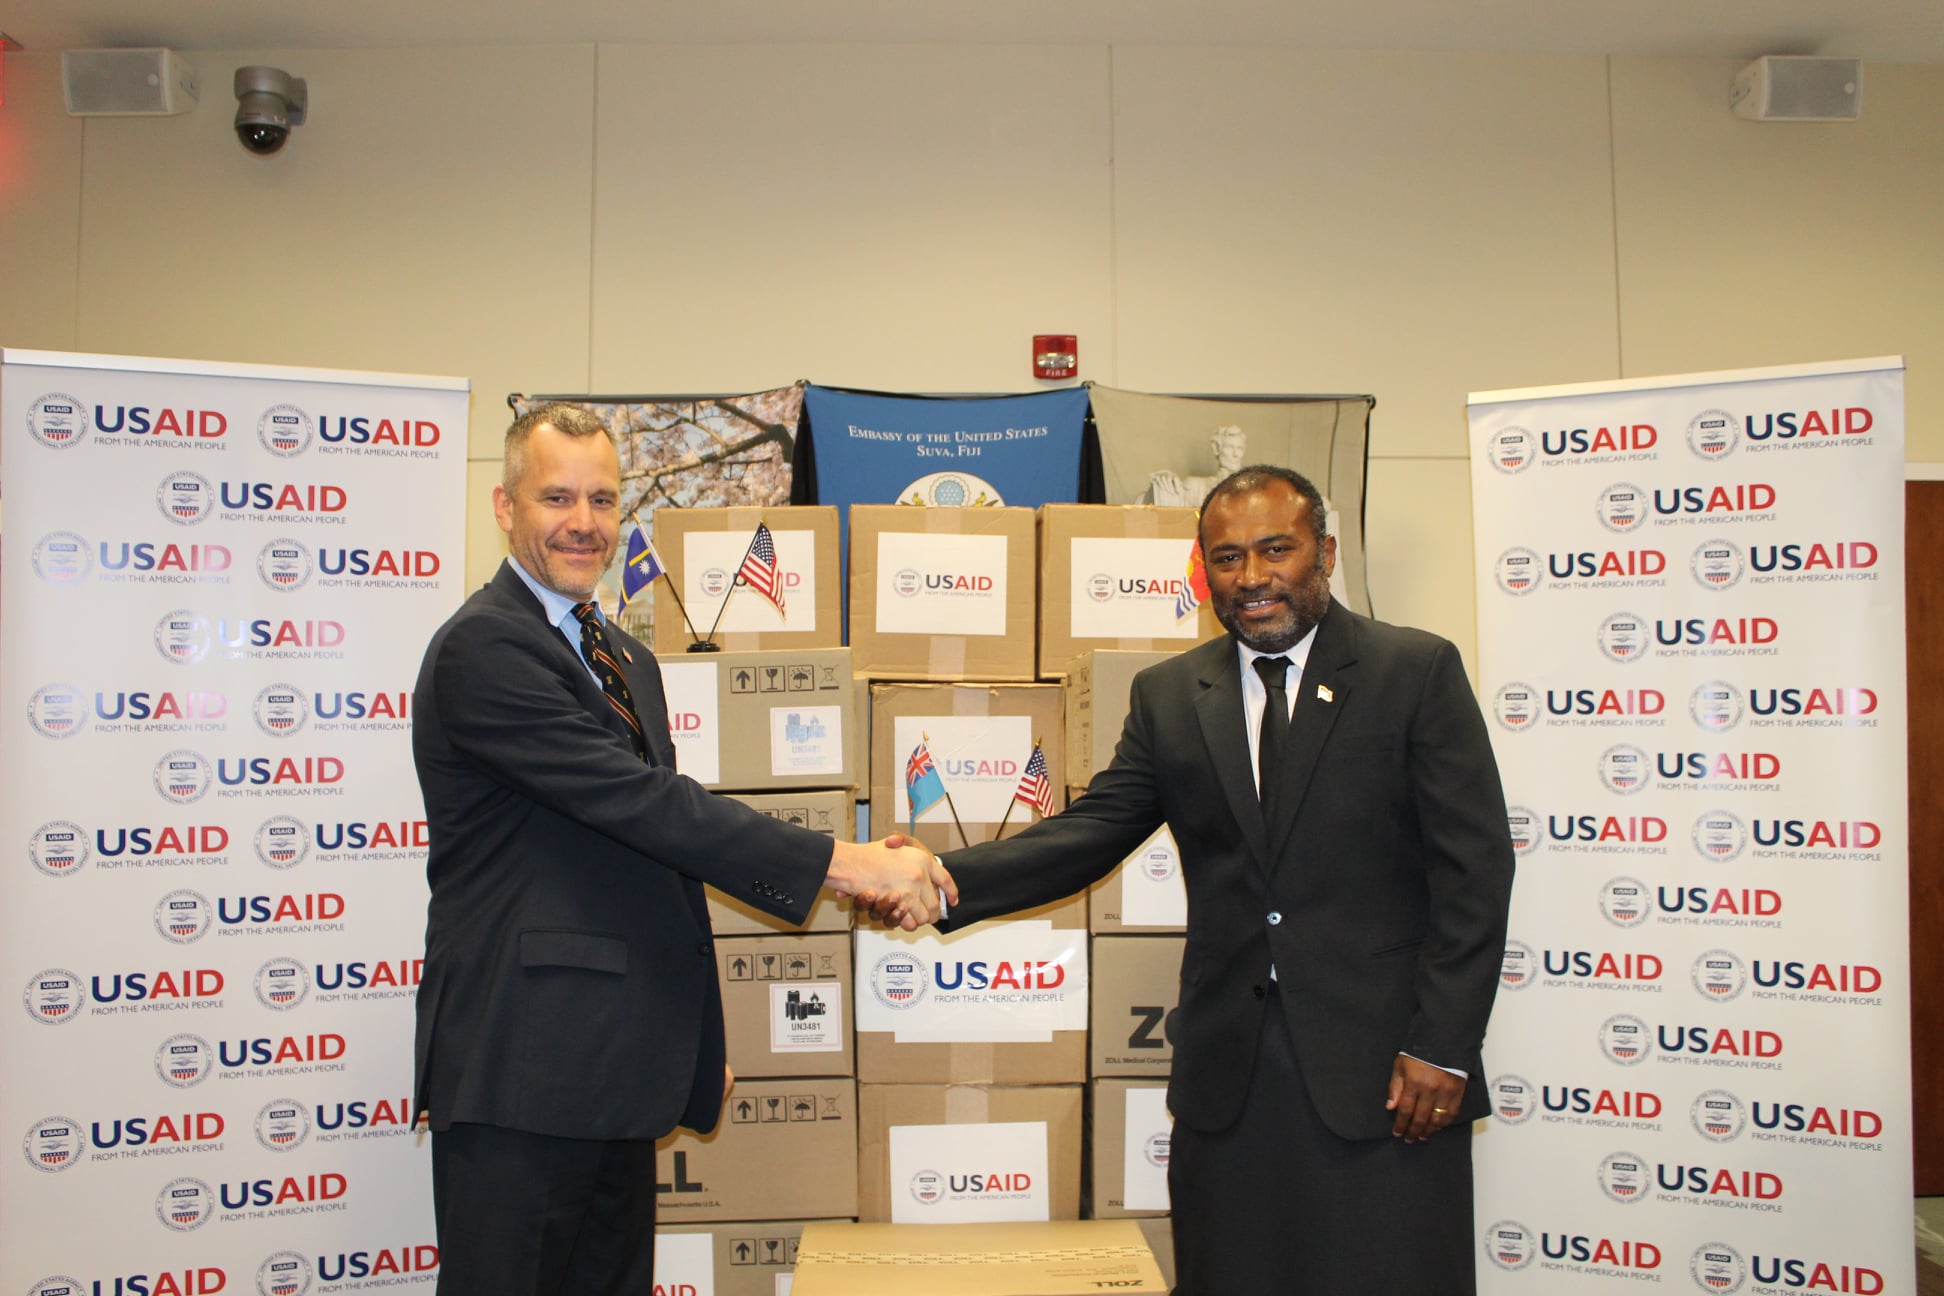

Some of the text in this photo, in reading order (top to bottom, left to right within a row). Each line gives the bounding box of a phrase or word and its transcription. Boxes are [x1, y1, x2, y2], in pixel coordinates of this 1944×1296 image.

[95, 405, 227, 438] USAID
[319, 416, 440, 447] USAID
[1746, 407, 1873, 440] USAID
[94, 436, 228, 451] FROM THE AMERICAN PEOPLE
[318, 445, 441, 460] FROM THE AMERICAN PEOPLE
[1542, 424, 1657, 455] USAID
[1745, 436, 1874, 453] FROM THE AMERICAN PEOPLE
[221, 482, 347, 512] USAID
[1654, 484, 1776, 514] USAID
[220, 512, 348, 524] FROM THE AMERICAN PEOPLE
[100, 542, 232, 572] USAID
[319, 548, 440, 577] USAID
[1549, 550, 1666, 578] USAID
[1750, 542, 1878, 572] USAID
[318, 578, 441, 590] FROM THE AMERICAN PEOPLE
[926, 574, 993, 591] USAID
[1119, 579, 1183, 595] USAID
[1749, 571, 1879, 585] FROM THE AMERICAN PEOPLE
[219, 619, 345, 647] USAID
[1656, 618, 1778, 646] USAID
[96, 691, 227, 720] USAID
[315, 692, 413, 719] USAI
[1547, 689, 1665, 715] USAID
[1750, 688, 1878, 715] USAID
[218, 757, 344, 785] USAID
[946, 760, 1017, 776] USAID
[1657, 753, 1780, 779] USAID
[97, 826, 229, 856] USAID
[1549, 815, 1667, 842] USAID
[1753, 820, 1882, 848] USAID
[96, 856, 230, 870] FROM THE AMERICAN PEOPLE
[218, 893, 345, 924] USAID
[1658, 886, 1782, 916] USAID
[217, 921, 346, 937] FROM THE AMERICAN PEOPLE
[934, 961, 1065, 990] USAID
[1544, 950, 1663, 980] USAID
[1753, 960, 1882, 993] USAID
[92, 970, 224, 1003] USAID
[934, 994, 1064, 1003] FROM THE AMERICAN PEOPLE
[1752, 989, 1883, 1007] FROM THE AMERICAN PEOPLE
[91, 999, 225, 1016] FROM THE AMERICAN PEOPLE
[791, 1023, 820, 1031] UN3481
[219, 1034, 346, 1067] USAID
[1658, 1025, 1783, 1058] USAID
[218, 1062, 347, 1080] FROM THE AMERICAN PEOPLE
[316, 1098, 415, 1130] USAI
[1542, 1085, 1662, 1118] USAID
[92, 1113, 224, 1148] USAID
[1752, 1102, 1882, 1138] USAID
[91, 1141, 225, 1162] FROM THE AMERICAN PEOPLE
[1751, 1131, 1883, 1152] FROM THE AMERICAN PEOPLE
[220, 1173, 347, 1209] USAID
[950, 1173, 1031, 1193] USAID
[1657, 1164, 1783, 1200] USAID
[219, 1201, 348, 1223] FROM THE AMERICAN PEOPLE
[1656, 1192, 1784, 1214] FROM THE AMERICAN PEOPLE
[318, 1245, 440, 1281] USAID
[1542, 1232, 1661, 1269] USAID
[93, 1268, 226, 1296] USAID
[653, 1284, 697, 1296] AID
[1091, 1279, 1143, 1287] ZOLL
[1752, 1256, 1884, 1296] USAID
